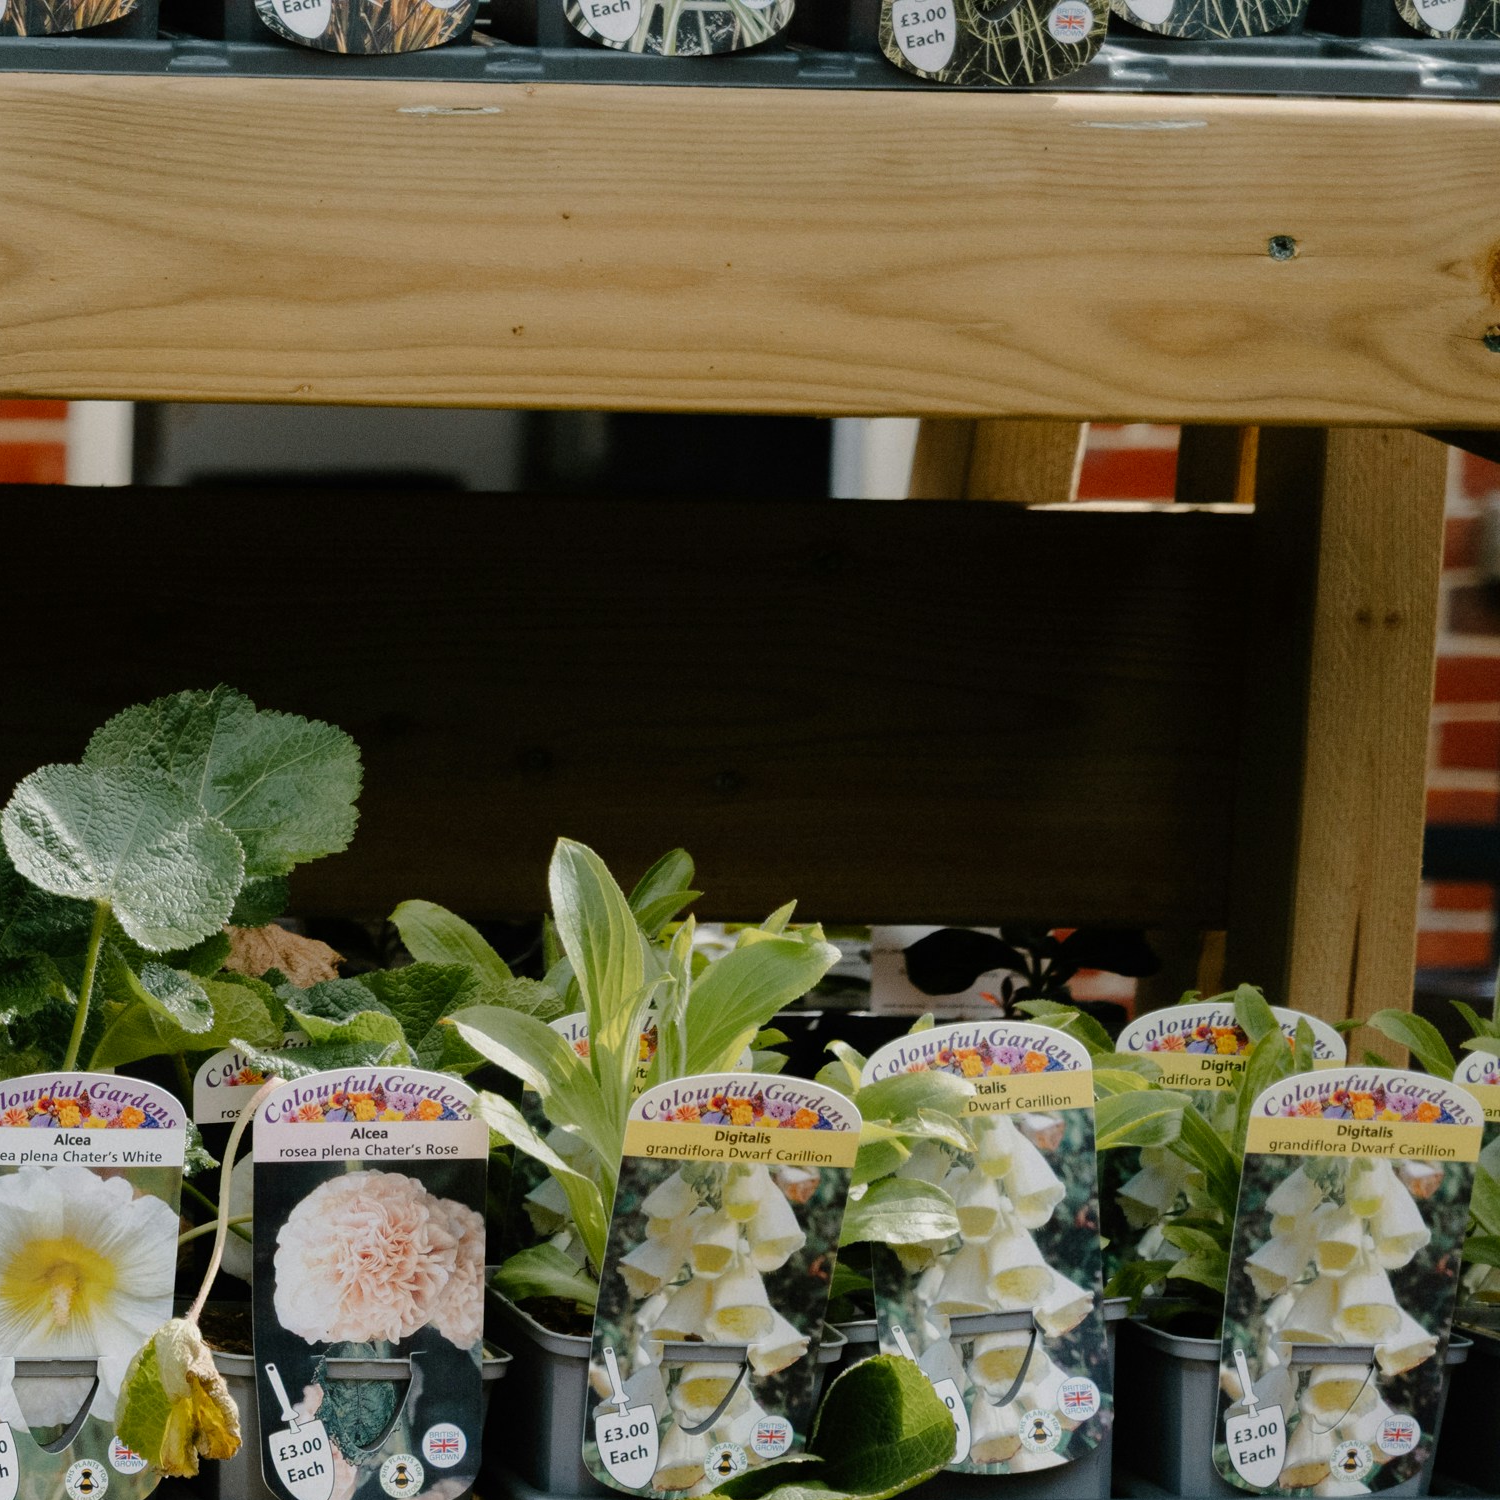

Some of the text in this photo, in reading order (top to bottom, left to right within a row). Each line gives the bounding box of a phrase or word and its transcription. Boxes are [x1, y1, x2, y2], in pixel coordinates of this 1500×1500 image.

[591, 0, 631, 18] Each
[900, 6, 947, 28] £3.00
[906, 29, 945, 49] Each
[1263, 1074, 1474, 1126] Colourful Gardens
[350, 1127, 389, 1140] Alcea
[1337, 1124, 1394, 1140] Digitalis
[279, 1143, 459, 1160] rosea plena Chater's Rose
[1268, 1139, 1456, 1157] grandiflora Dwarf Carillion
[1233, 1421, 1278, 1445] £3.00
[279, 1437, 323, 1462] £3.00
[1238, 1445, 1277, 1466] Each
[287, 1461, 325, 1484] Each
